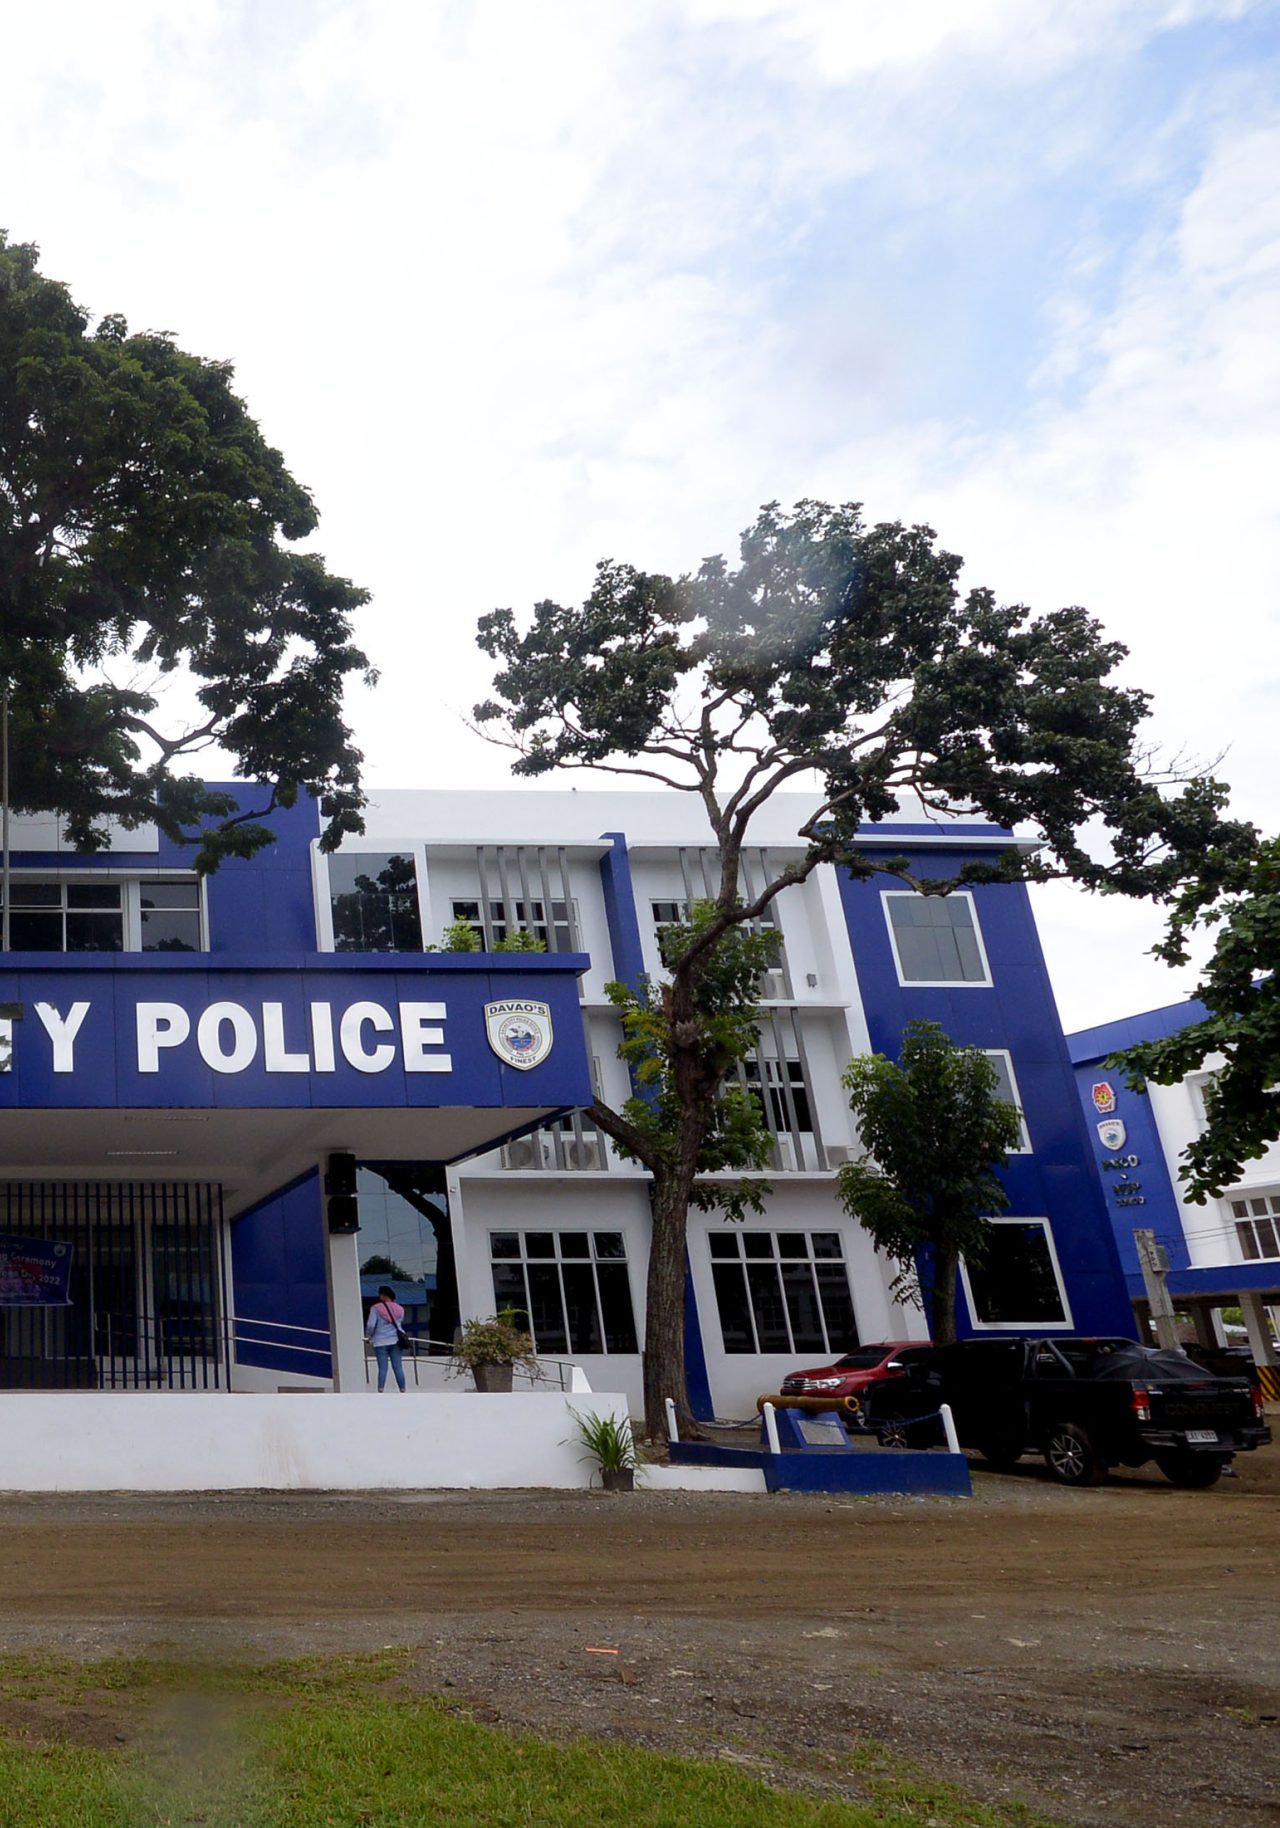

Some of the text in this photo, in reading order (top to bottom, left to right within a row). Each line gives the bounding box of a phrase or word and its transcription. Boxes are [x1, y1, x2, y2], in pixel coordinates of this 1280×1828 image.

[489, 1003, 546, 1015] DAVAO'S
[136, 1001, 453, 1074] POLICE
[510, 1056, 537, 1064] FINEST
